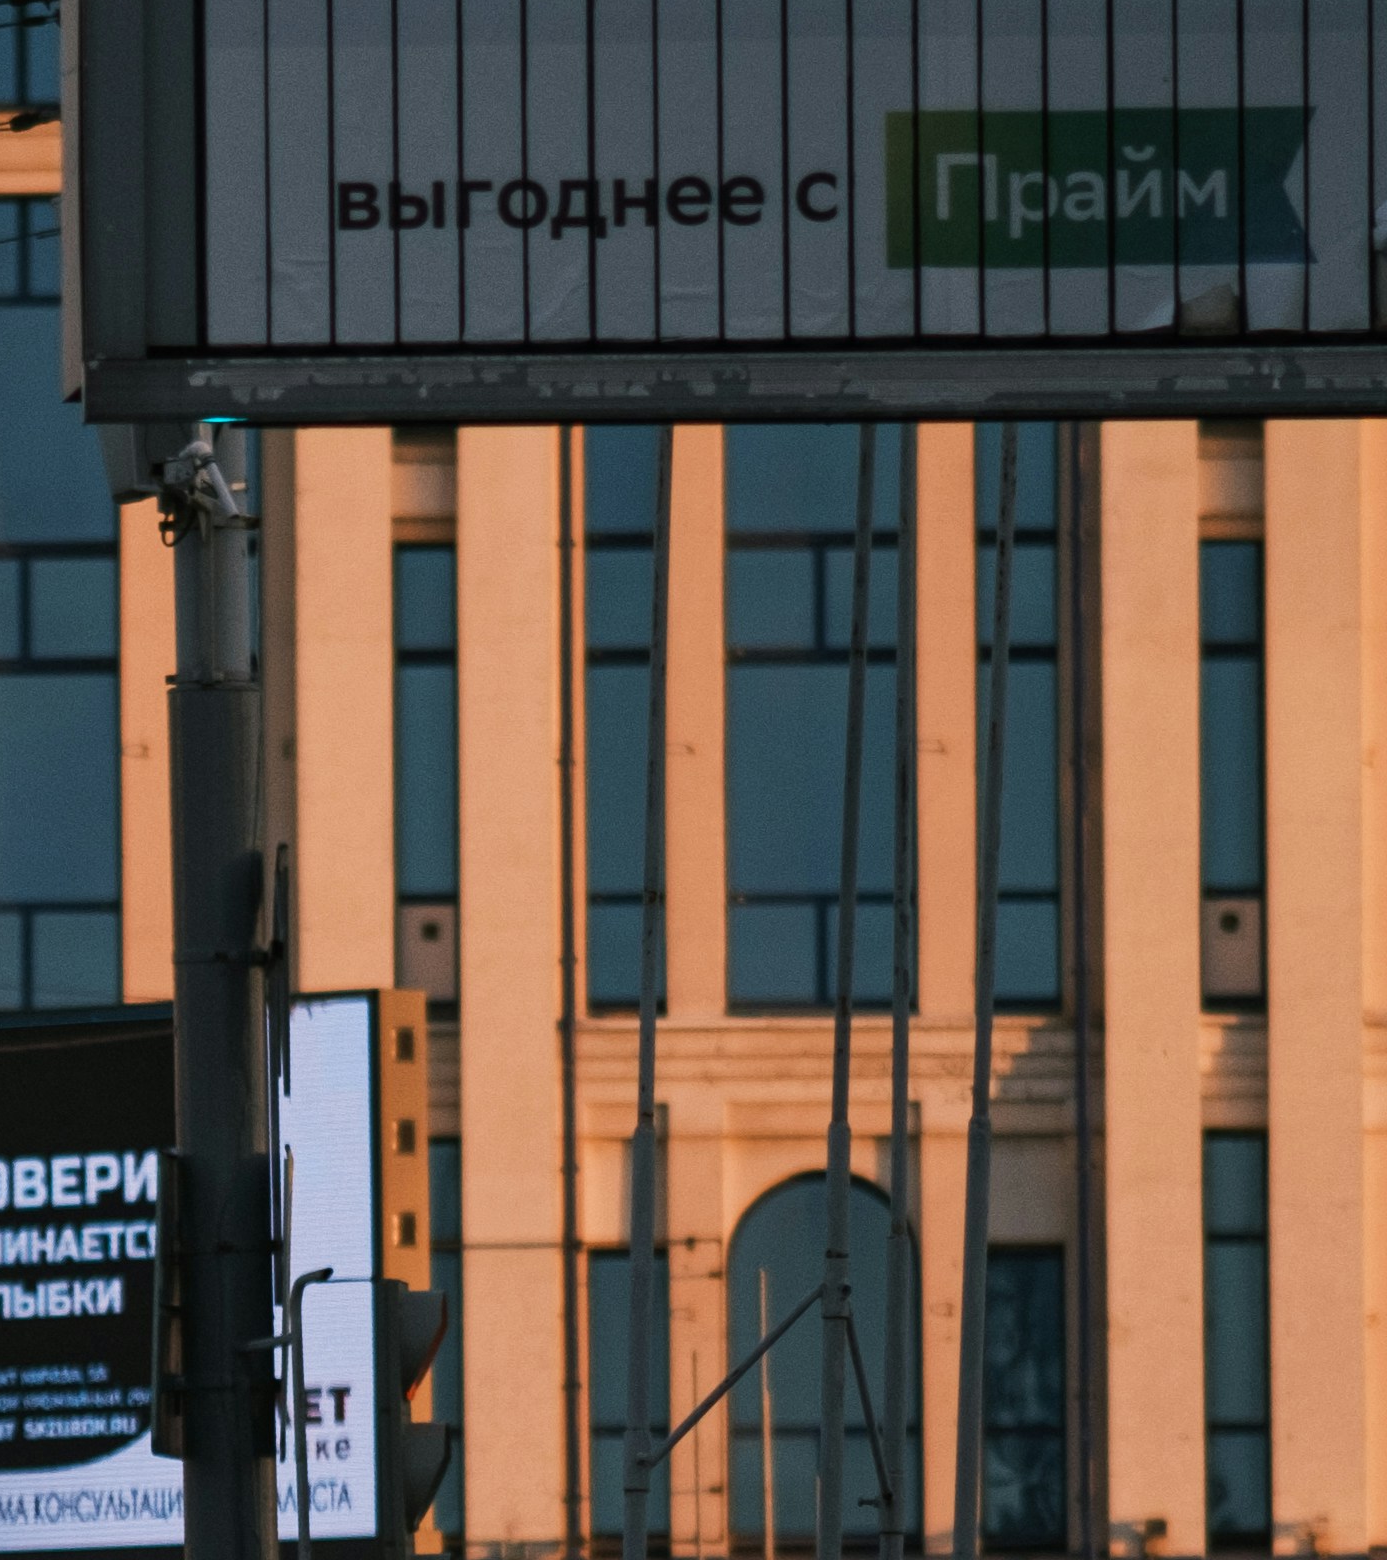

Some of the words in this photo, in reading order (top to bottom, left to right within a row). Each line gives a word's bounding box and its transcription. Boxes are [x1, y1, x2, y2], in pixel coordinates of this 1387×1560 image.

[336, 174, 763, 240] выгоднее
[796, 170, 839, 224] с
[934, 146, 1230, 238] Прайм
[33, 1486, 184, 1526] КОНСУЛЬТАЦИ
